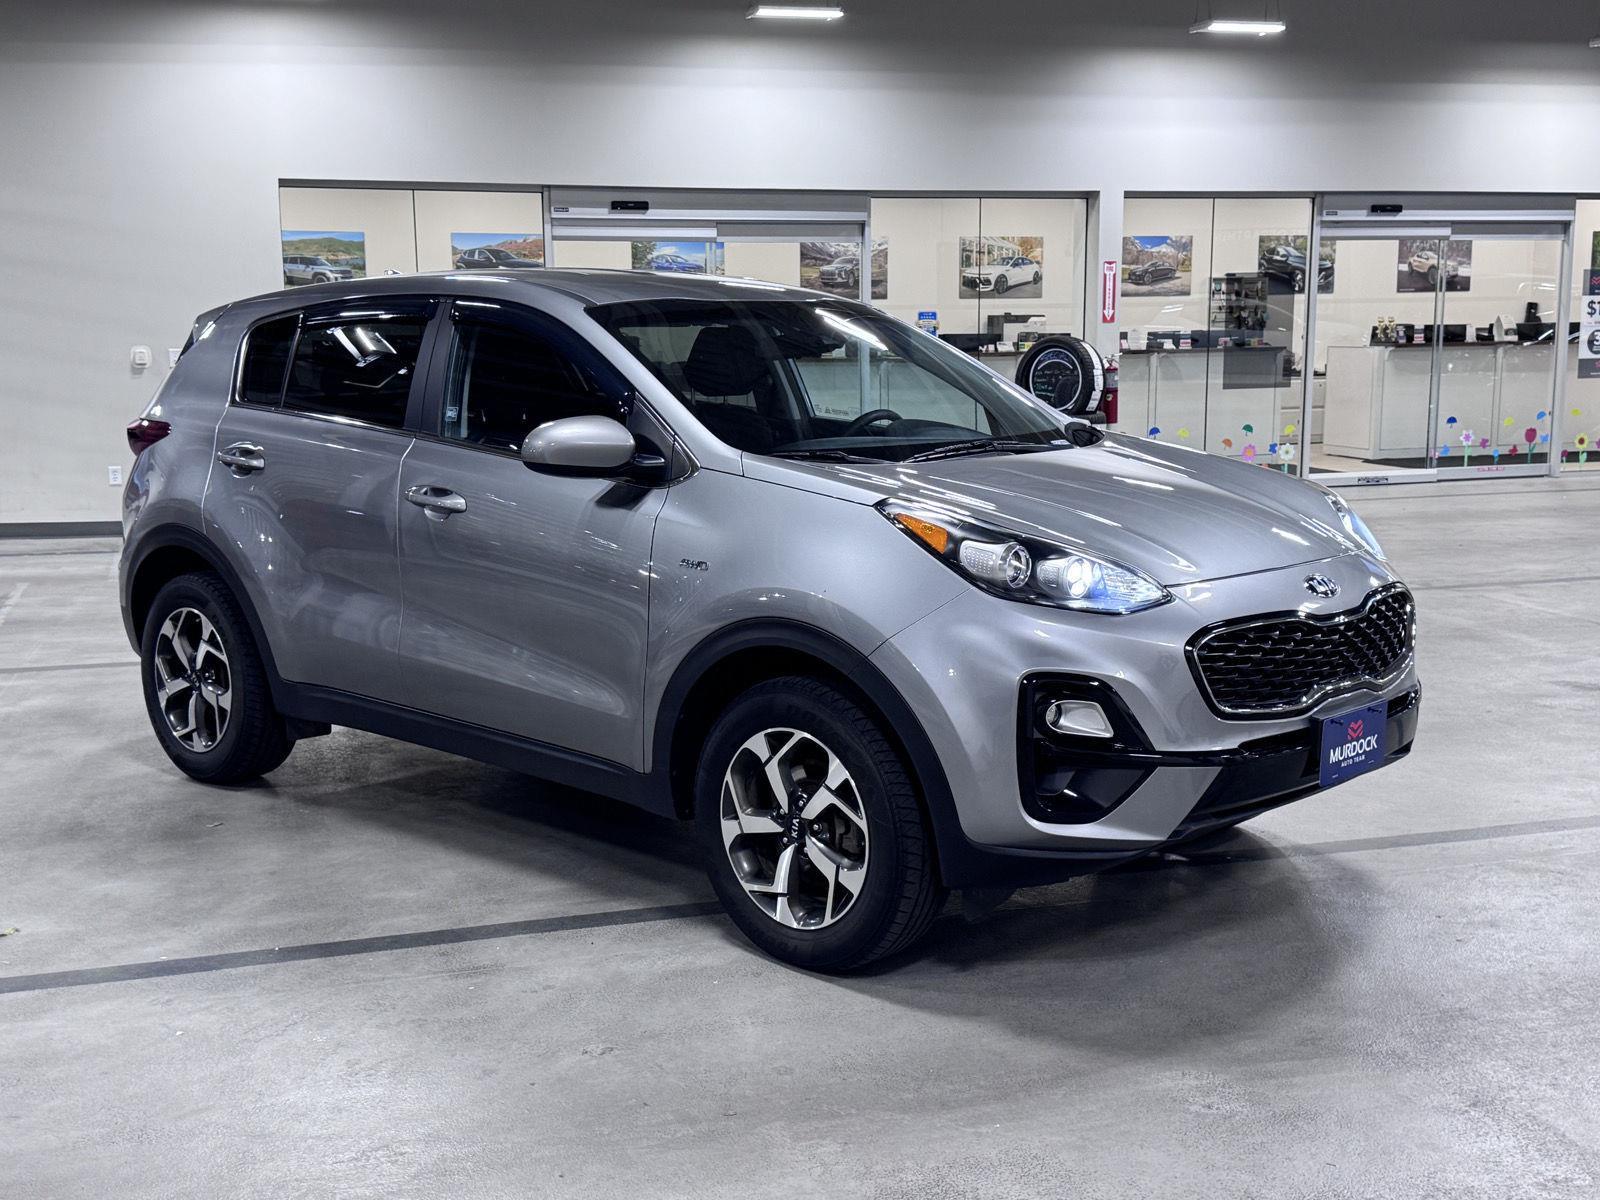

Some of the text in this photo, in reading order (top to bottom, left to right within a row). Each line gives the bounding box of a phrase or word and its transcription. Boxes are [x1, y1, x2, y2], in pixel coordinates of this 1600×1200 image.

[1329, 734, 1378, 764] MURDOCK
[1341, 758, 1353, 767] AUTO
[791, 818, 800, 838] KIA
